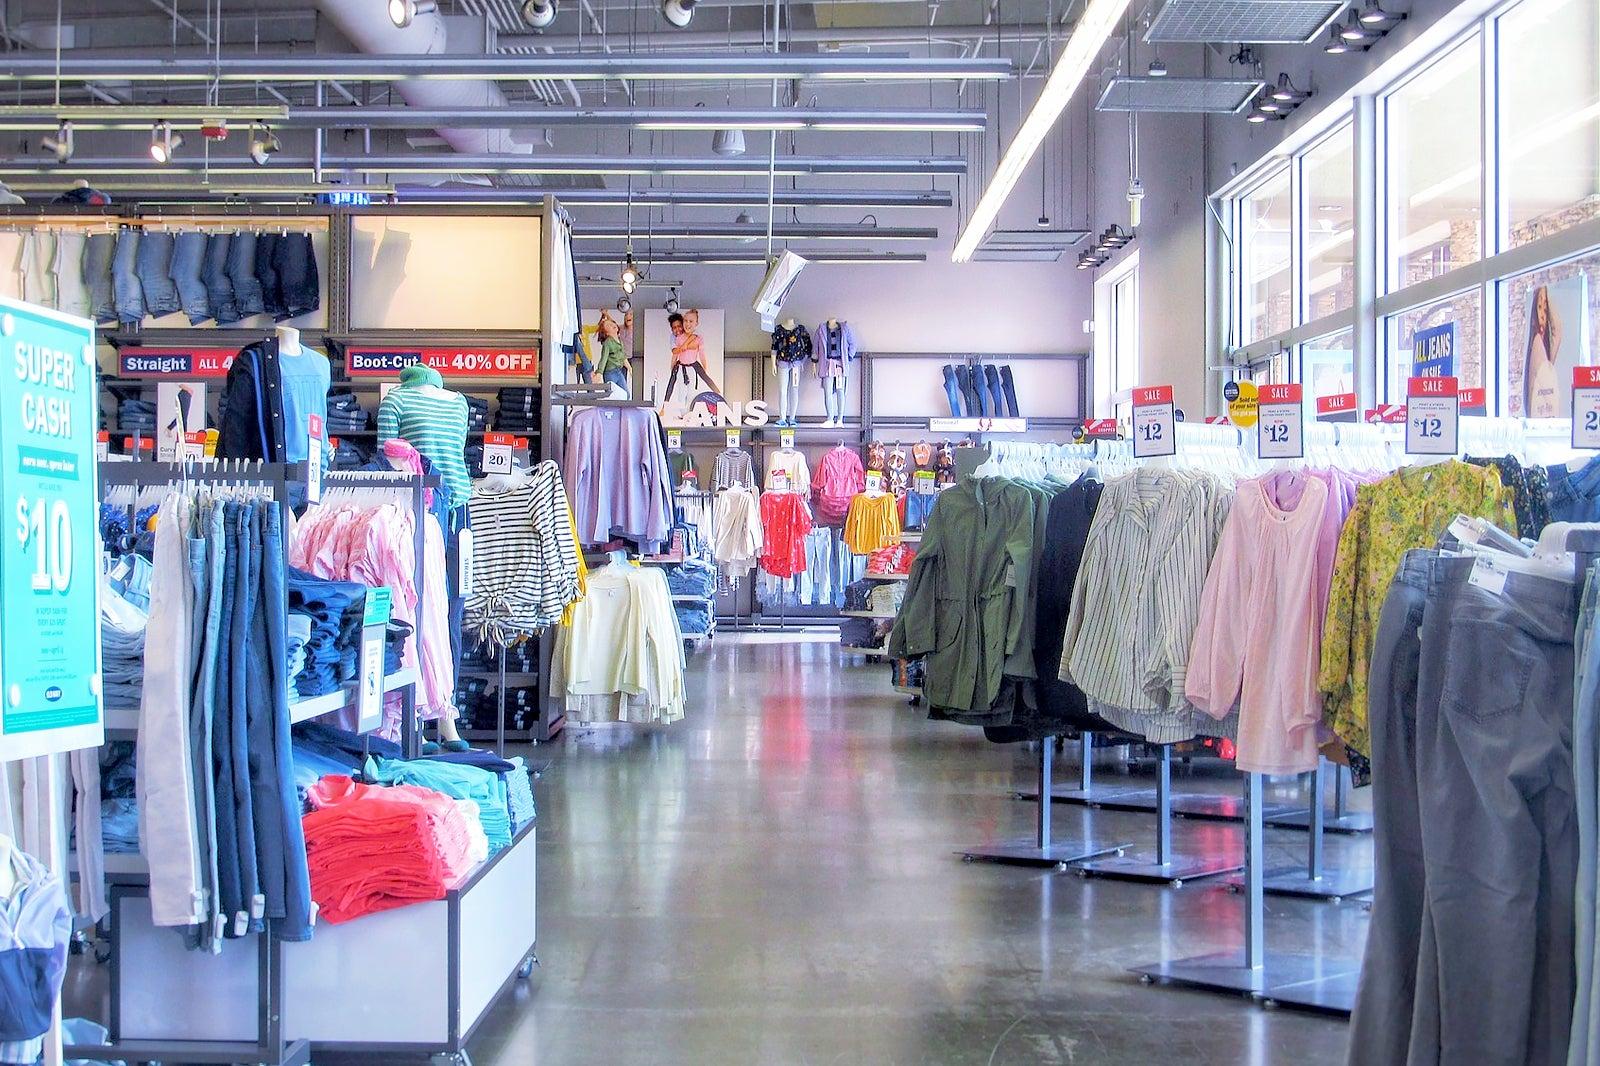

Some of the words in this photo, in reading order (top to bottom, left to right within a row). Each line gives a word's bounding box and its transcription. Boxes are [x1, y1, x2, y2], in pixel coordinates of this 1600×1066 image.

[1415, 339, 1427, 363] ALL
[1428, 332, 1451, 361] JEANS
[15, 340, 76, 393] SUPER
[126, 357, 187, 373] Straight
[199, 358, 219, 370] ALL
[353, 355, 419, 369] Boot-Cut
[428, 357, 449, 368] ALL
[451, 354, 492, 370] 40%
[495, 354, 533, 370] OFF
[1271, 387, 1289, 399] SALE
[1422, 380, 1443, 392] SALE
[1144, 389, 1161, 401] SALE
[1328, 397, 1344, 409] SALE
[1459, 391, 1473, 403] ALE
[22, 392, 72, 440] CASH
[1138, 422, 1162, 441] $12
[1263, 424, 1289, 442] $12
[1413, 418, 1442, 438] $12
[488, 454, 505, 466] 20
[16, 495, 73, 596] $10
